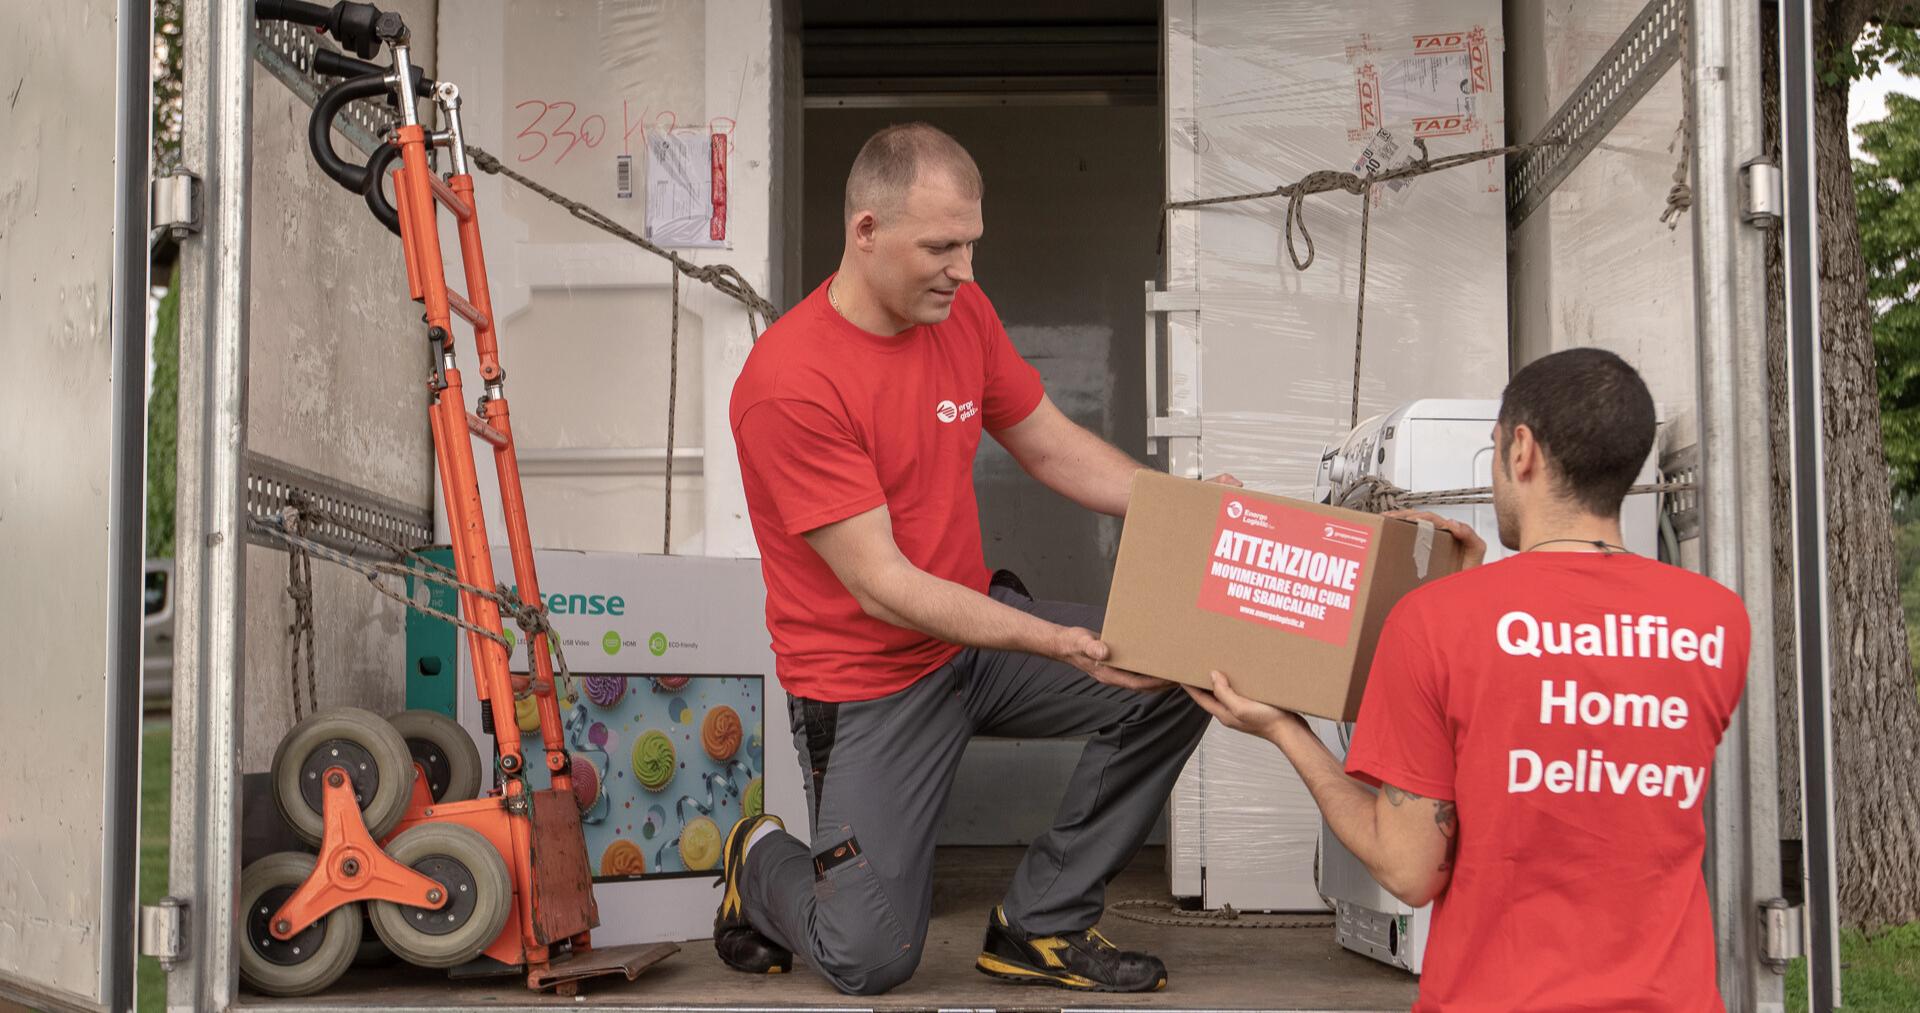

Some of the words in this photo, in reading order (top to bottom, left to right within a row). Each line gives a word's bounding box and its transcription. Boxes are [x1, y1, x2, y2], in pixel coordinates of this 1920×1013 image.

[1413, 34, 1463, 50] TAD
[1472, 45, 1486, 94] TAD
[1362, 81, 1376, 130] TAD
[1413, 117, 1463, 132] TAD
[1214, 529, 1360, 591] ATTENZIONE
[1211, 561, 1292, 595] MOVIMENTARE
[1292, 582, 1319, 604] CON
[1318, 588, 1351, 611] CURA
[1227, 581, 1254, 601] NON
[1252, 588, 1327, 621] SBANCALARE
[622, 640, 637, 648] HDMI
[1496, 611, 1725, 669] Qualified
[1539, 679, 1689, 730] Home
[1508, 749, 1706, 810] Delivery
